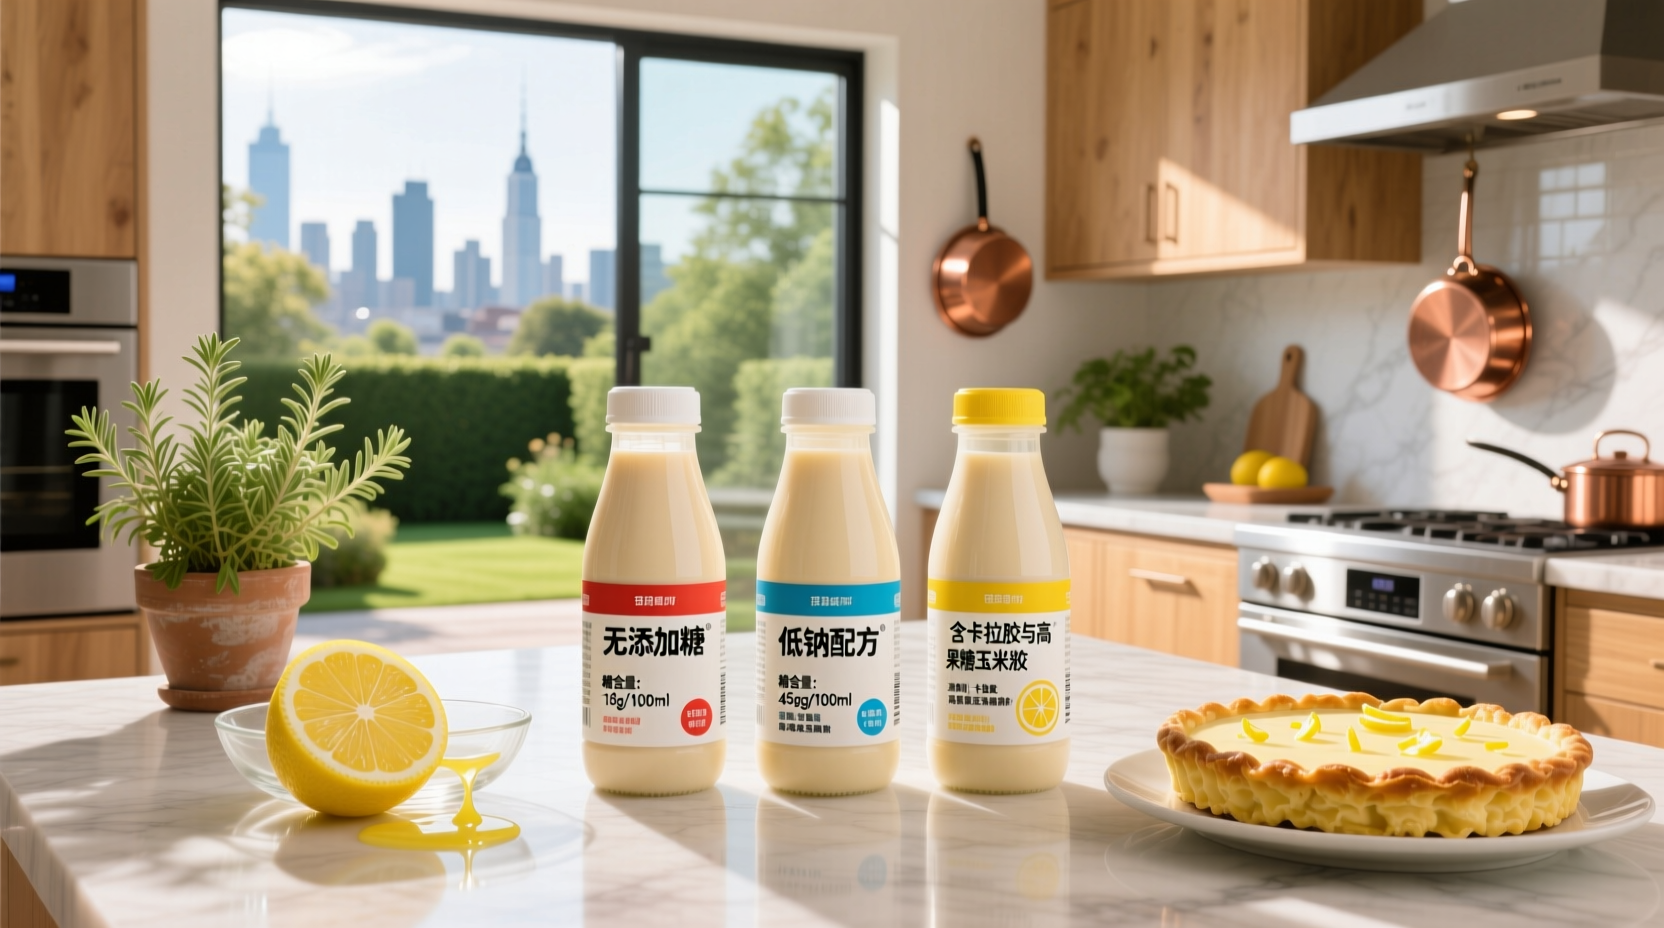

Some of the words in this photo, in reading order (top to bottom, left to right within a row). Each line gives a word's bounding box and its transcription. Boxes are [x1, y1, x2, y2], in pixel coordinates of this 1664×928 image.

[603, 626, 705, 657] 无添加糖
[778, 626, 879, 658] 低钠配方
[950, 621, 1051, 645] 含卡拉胶与高
[778, 692, 851, 710] 45gg/100ml
